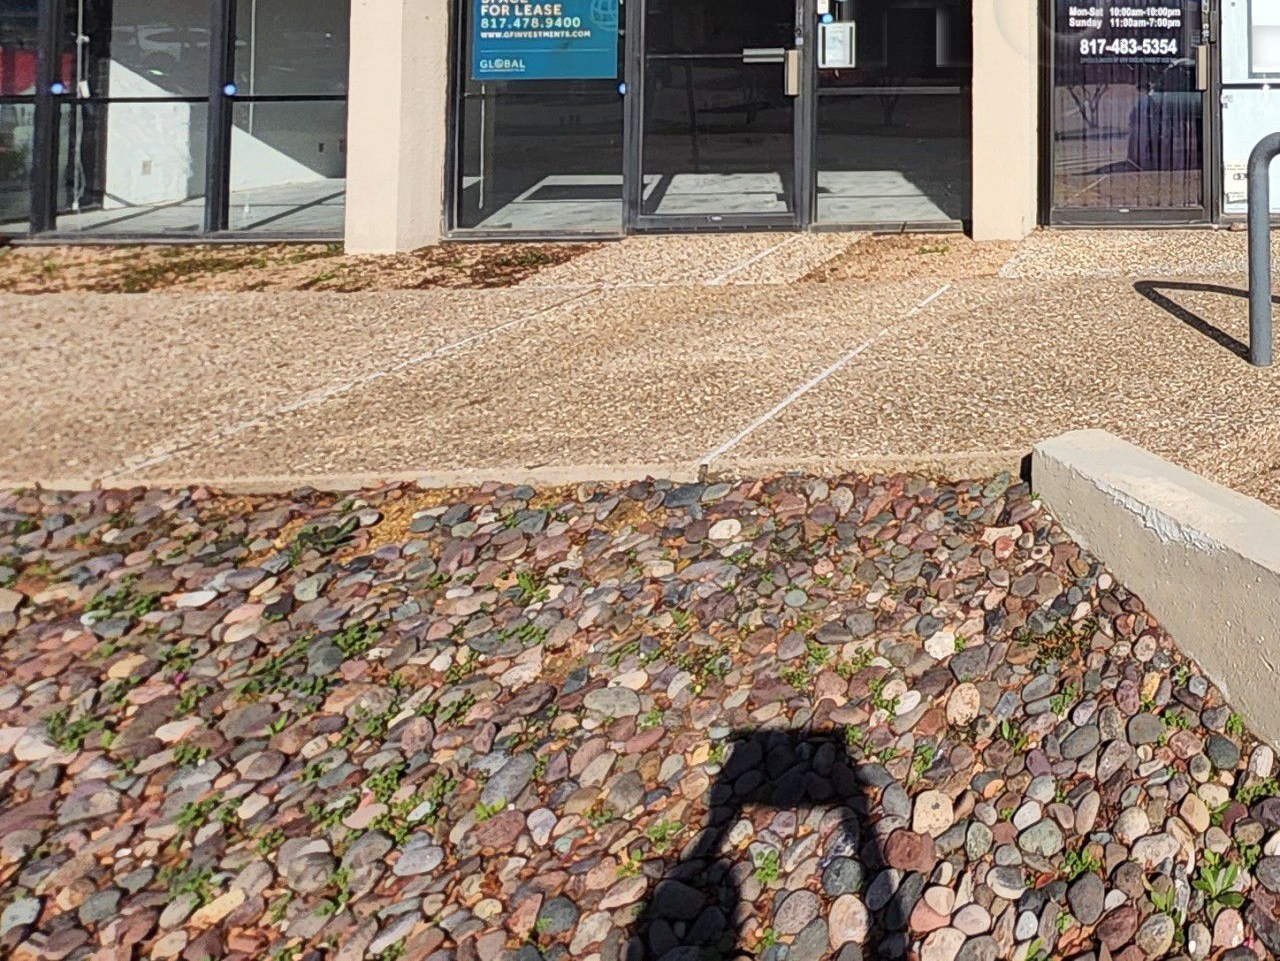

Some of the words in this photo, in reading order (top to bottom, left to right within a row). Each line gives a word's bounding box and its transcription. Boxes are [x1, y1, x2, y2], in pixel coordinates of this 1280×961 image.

[481, 5, 510, 16] FOR
[515, 4, 562, 16] LEASE
[1069, 7, 1103, 17] Mon-Sat
[481, 17, 581, 29] 817.478.9400
[1069, 17, 1102, 29] Sunday
[1080, 38, 1178, 55] 817-483-5354
